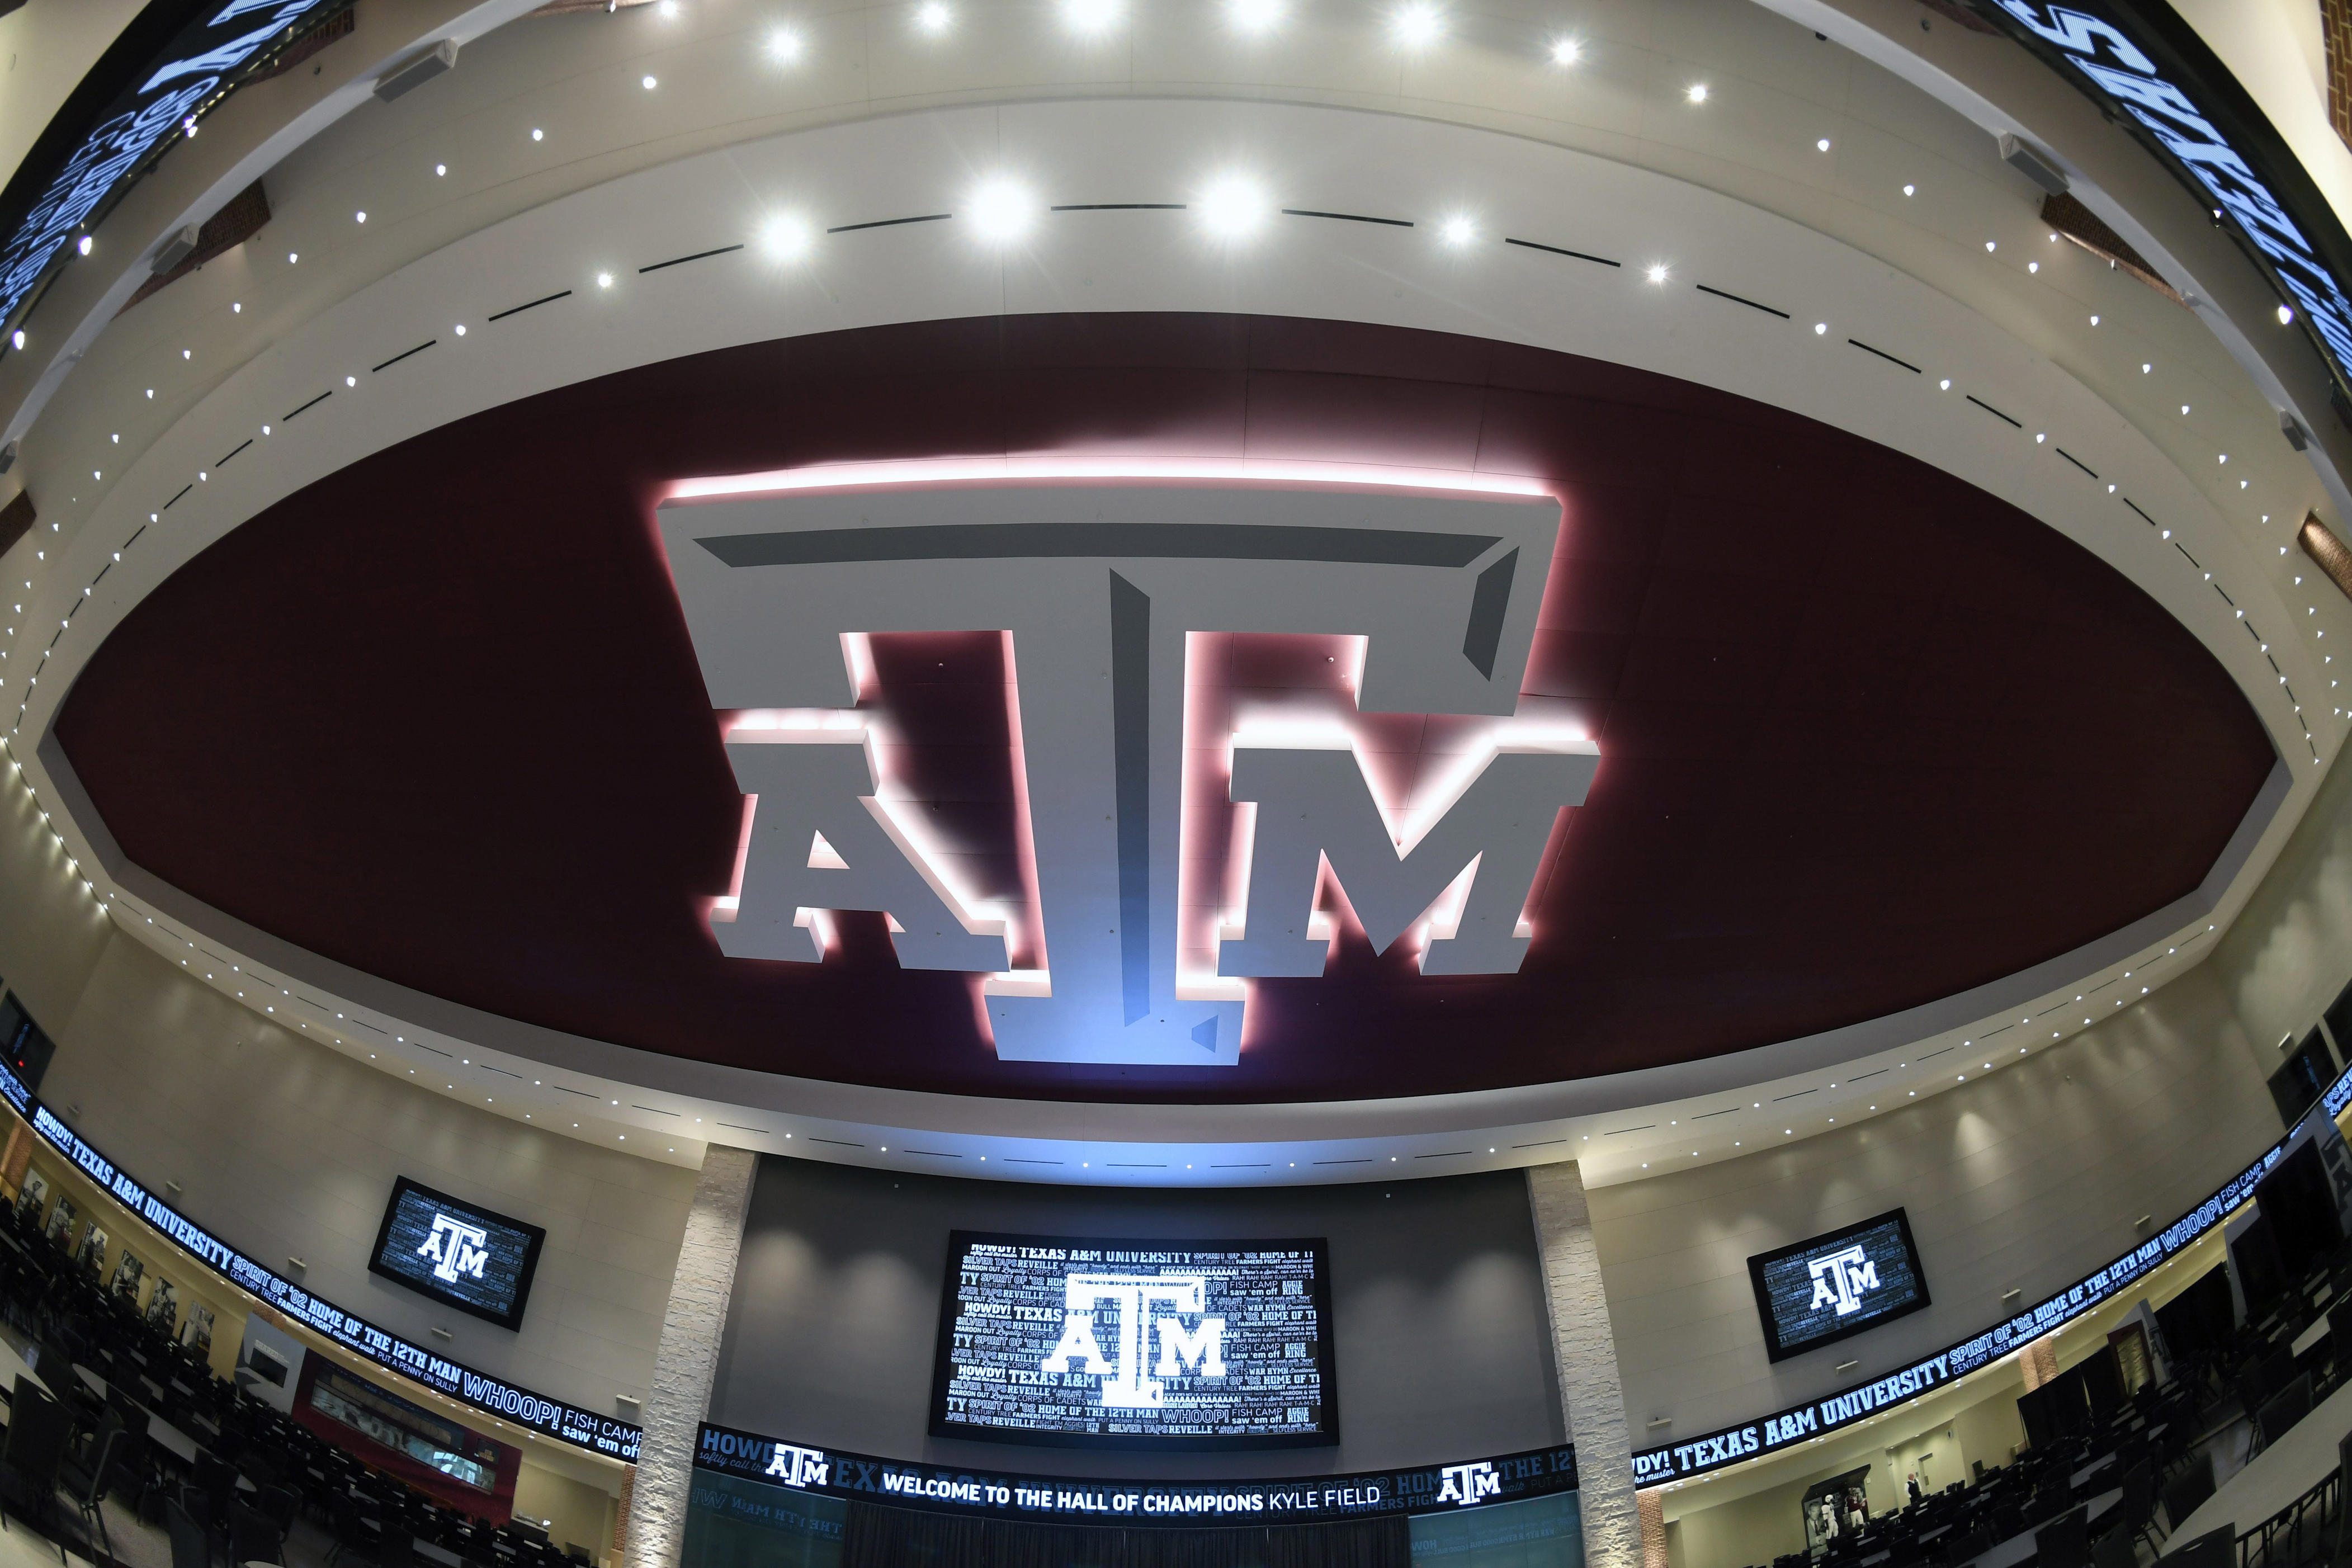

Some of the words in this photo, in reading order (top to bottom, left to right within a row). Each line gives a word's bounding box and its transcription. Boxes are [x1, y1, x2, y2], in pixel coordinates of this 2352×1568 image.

[2224, 1194, 2240, 1212] saw
[1820, 1236, 1854, 1251] UNIVERSITY
[963, 1255, 993, 1265] SILVER
[995, 1258, 1017, 1267] TAPS
[1018, 1260, 1059, 1269] REVEILLE
[1070, 1250, 1102, 1262] A&M
[1106, 1251, 1191, 1263] UNIVERSITY
[36, 1106, 73, 1146] HOWDY!
[72, 1138, 114, 1185] TEXAS
[112, 1173, 145, 1210] A&M
[144, 1196, 234, 1271] UNIVERSITY
[233, 1255, 272, 1287] SPIRIT
[270, 1278, 289, 1296] OF
[308, 1298, 344, 1328] HOME
[344, 1317, 363, 1336] OF
[365, 1326, 391, 1352] THE
[392, 1340, 428, 1369] 12TH
[428, 1357, 462, 1383] MAN
[464, 1371, 562, 1430] WHOOP!
[565, 1409, 598, 1432] FISH
[960, 1271, 980, 1285] TY
[980, 1273, 1013, 1284] SPIRIT
[1013, 1275, 1028, 1284] OF
[964, 1302, 1011, 1315] HOWDY!
[1013, 1305, 1062, 1322] TEXAS
[1674, 1427, 1759, 1471] TEXAS
[1765, 1408, 1817, 1446] A&M
[1820, 1354, 1948, 1425] UNIVERSITY
[1949, 1333, 1993, 1365] SPIRIT
[1994, 1323, 2012, 1343] OF
[2034, 1297, 2068, 1323] HOME
[2069, 1284, 2083, 1304] OF
[2085, 1270, 2109, 1295] THE
[2109, 1253, 2137, 1281] 12TH
[2136, 1238, 2162, 1263] MAN
[2160, 1196, 2223, 1253] WHOOP!
[2221, 1180, 2240, 1202] FISH
[2240, 1163, 2262, 1187] CAMP
[1953, 1353, 1987, 1375] CENTURY
[1991, 1342, 2009, 1357] TREE
[2009, 1325, 2043, 1348] FARMERS
[2043, 1312, 2064, 1330] FIGHT
[2065, 1297, 2089, 1317] elephant
[2089, 1292, 2102, 1304] walk
[2104, 1283, 2115, 1295] PUT
[2120, 1268, 2139, 1286] PENNY
[2139, 1263, 2148, 1273] ON
[2148, 1252, 2163, 1267] SULLY
[230, 1268, 260, 1292] CENTURY
[261, 1287, 278, 1303] TREE
[277, 1297, 311, 1323] FARMERS
[310, 1317, 334, 1334] FIGHT
[333, 1329, 360, 1348] elephant
[358, 1342, 375, 1356] walk
[377, 1350, 391, 1363] PUT
[391, 1358, 397, 1367] A
[399, 1361, 422, 1378] PENNY
[423, 1372, 434, 1383] ON
[435, 1378, 457, 1393] SULLY
[1194, 1376, 1227, 1385] SPIRIT
[1229, 1376, 1243, 1385] OF
[1264, 1375, 1291, 1385] HOME
[1293, 1374, 1307, 1383] OF
[1038, 1404, 1067, 1415] HOME
[1069, 1406, 1082, 1416] OF
[1085, 1407, 1106, 1417] THE
[1108, 1408, 1134, 1418] 12TH
[1136, 1409, 1159, 1419] MAN
[1161, 1409, 1229, 1424] WHOOP!
[1232, 1408, 1253, 1417] FISH
[1255, 1408, 1283, 1416] CAMP
[1287, 1414, 1309, 1423] RING
[562, 1425, 591, 1443] saw
[1108, 1423, 1142, 1433] SILVER
[1144, 1425, 1168, 1434] TAPS
[1169, 1425, 1213, 1434] REVEILLE
[699, 1450, 728, 1467] softly
[730, 1458, 749, 1470] call
[750, 1463, 767, 1473] the
[766, 1443, 829, 1487] ATM
[1499, 1454, 1543, 1481] THE
[1549, 1448, 1575, 1472] 12
[1437, 1462, 1501, 1505] ATM
[1531, 1476, 1552, 1490] PUT
[1555, 1475, 1563, 1484] A
[1634, 1475, 1645, 1484] he
[1646, 1467, 1675, 1482] muster
[884, 1473, 980, 1501] WELCOME
[985, 1485, 1010, 1504] TO
[1014, 1488, 1052, 1508] THE
[1057, 1491, 1108, 1510] HALL
[1113, 1494, 1139, 1511] OF
[1143, 1494, 1263, 1512] CHAMPIONS
[1270, 1491, 1319, 1510] KYLE
[1325, 1486, 1380, 1506] FIELD
[1306, 1503, 1337, 1517] TREE
[1340, 1496, 1404, 1513] FARMERS
[1408, 1495, 1441, 1508] FIGH
